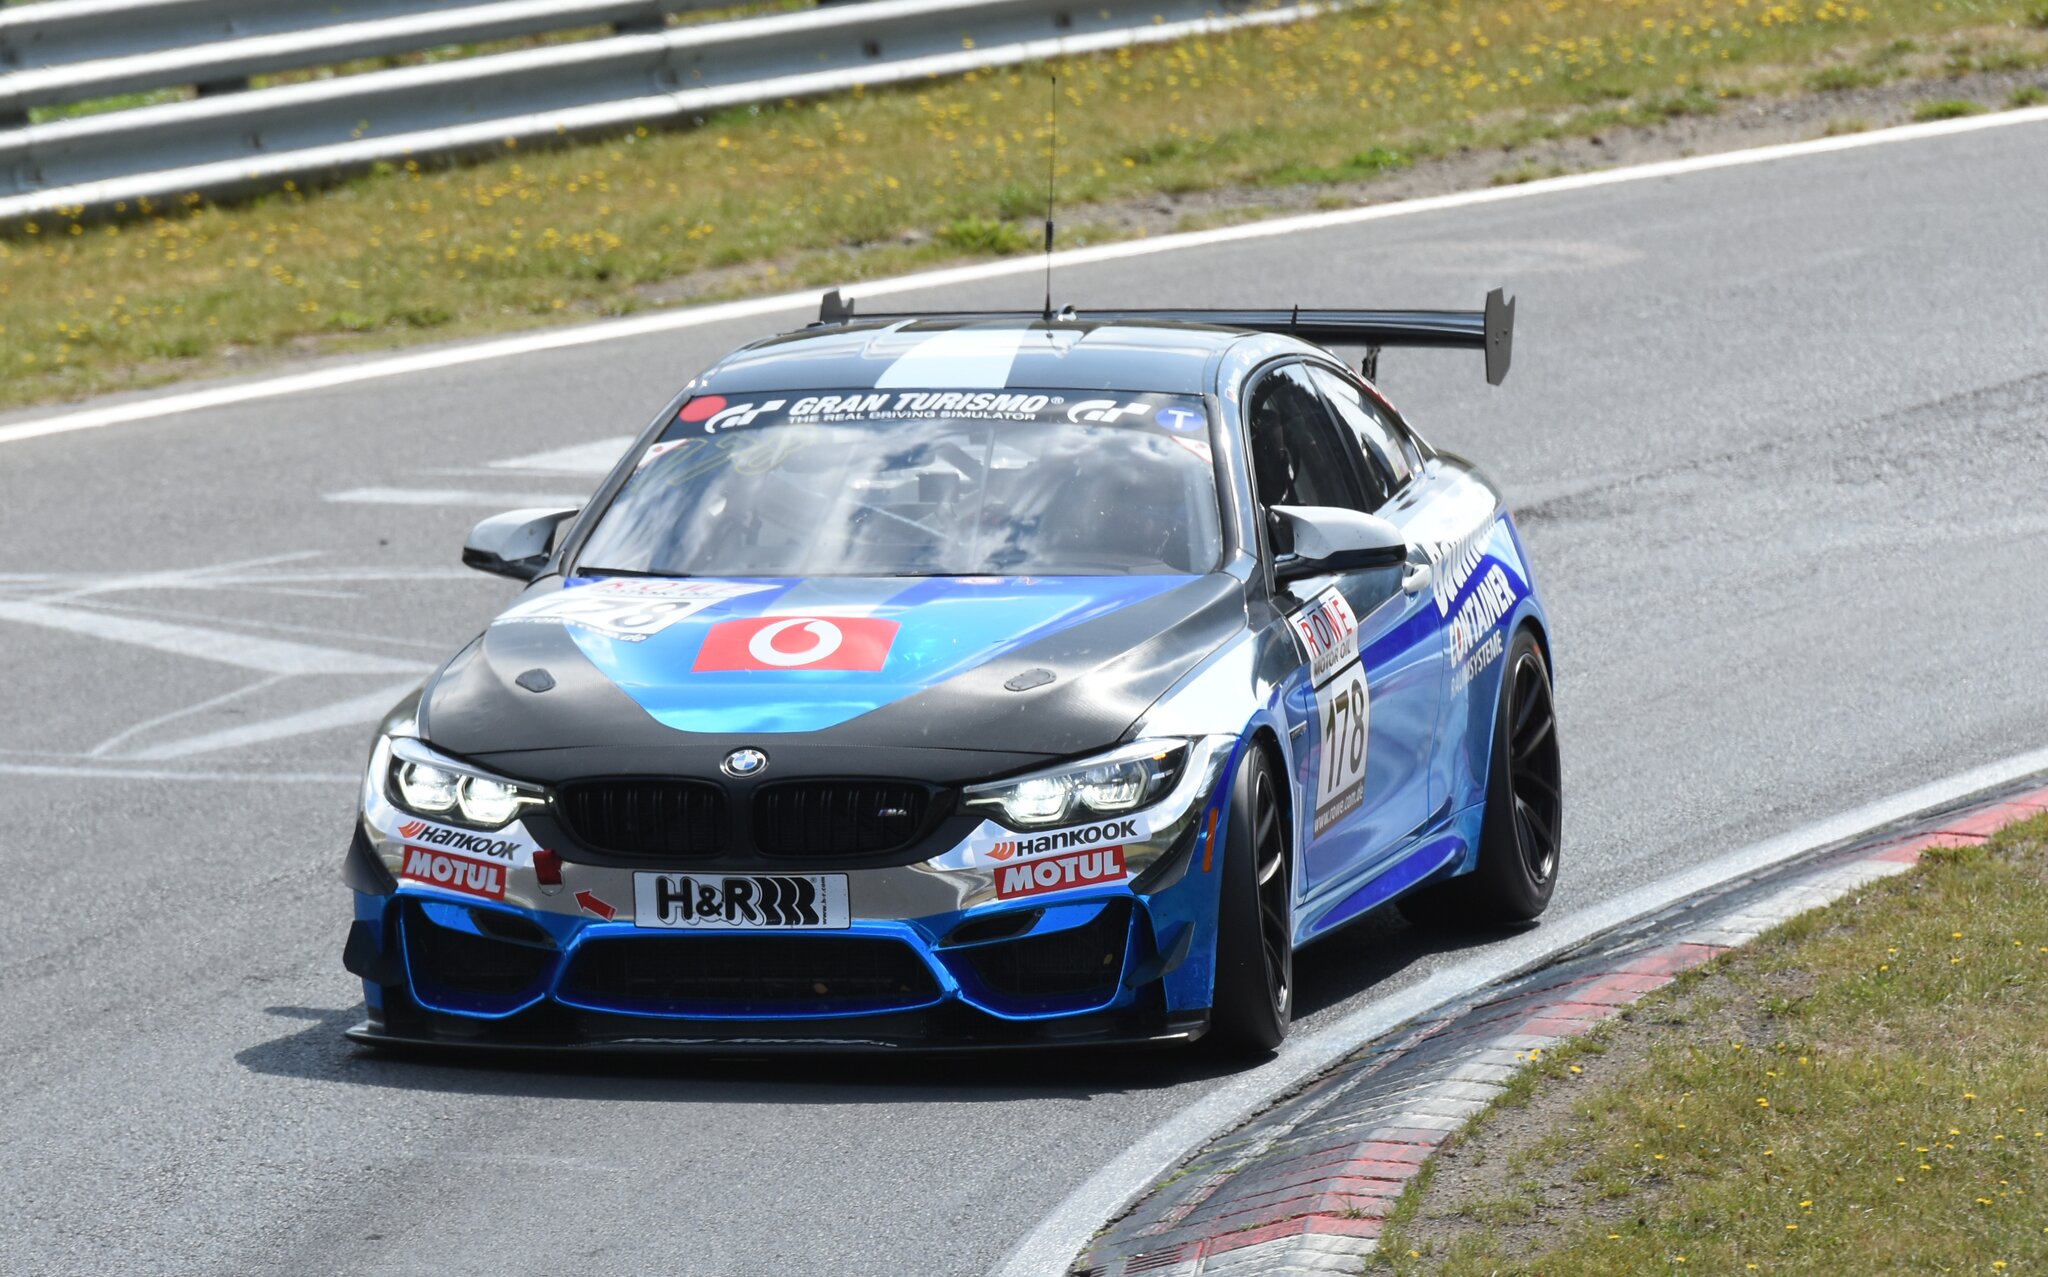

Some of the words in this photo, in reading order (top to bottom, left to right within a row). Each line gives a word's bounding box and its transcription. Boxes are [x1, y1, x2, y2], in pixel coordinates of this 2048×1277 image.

[788, 393, 890, 416] GRAN
[789, 414, 820, 424] THE
[823, 412, 865, 422] REAL
[869, 410, 936, 420] DRIVING
[940, 410, 1036, 421] SIMULATOR
[1168, 409, 1194, 429] T
[1300, 599, 1353, 657] ROWE
[1449, 563, 1517, 669] CONTAINER
[1313, 647, 1339, 676] MOTOR
[1340, 639, 1351, 659] OIL
[1326, 678, 1364, 794] 178
[405, 850, 501, 894] MOTUL
[1002, 850, 1121, 894] MOTUL
